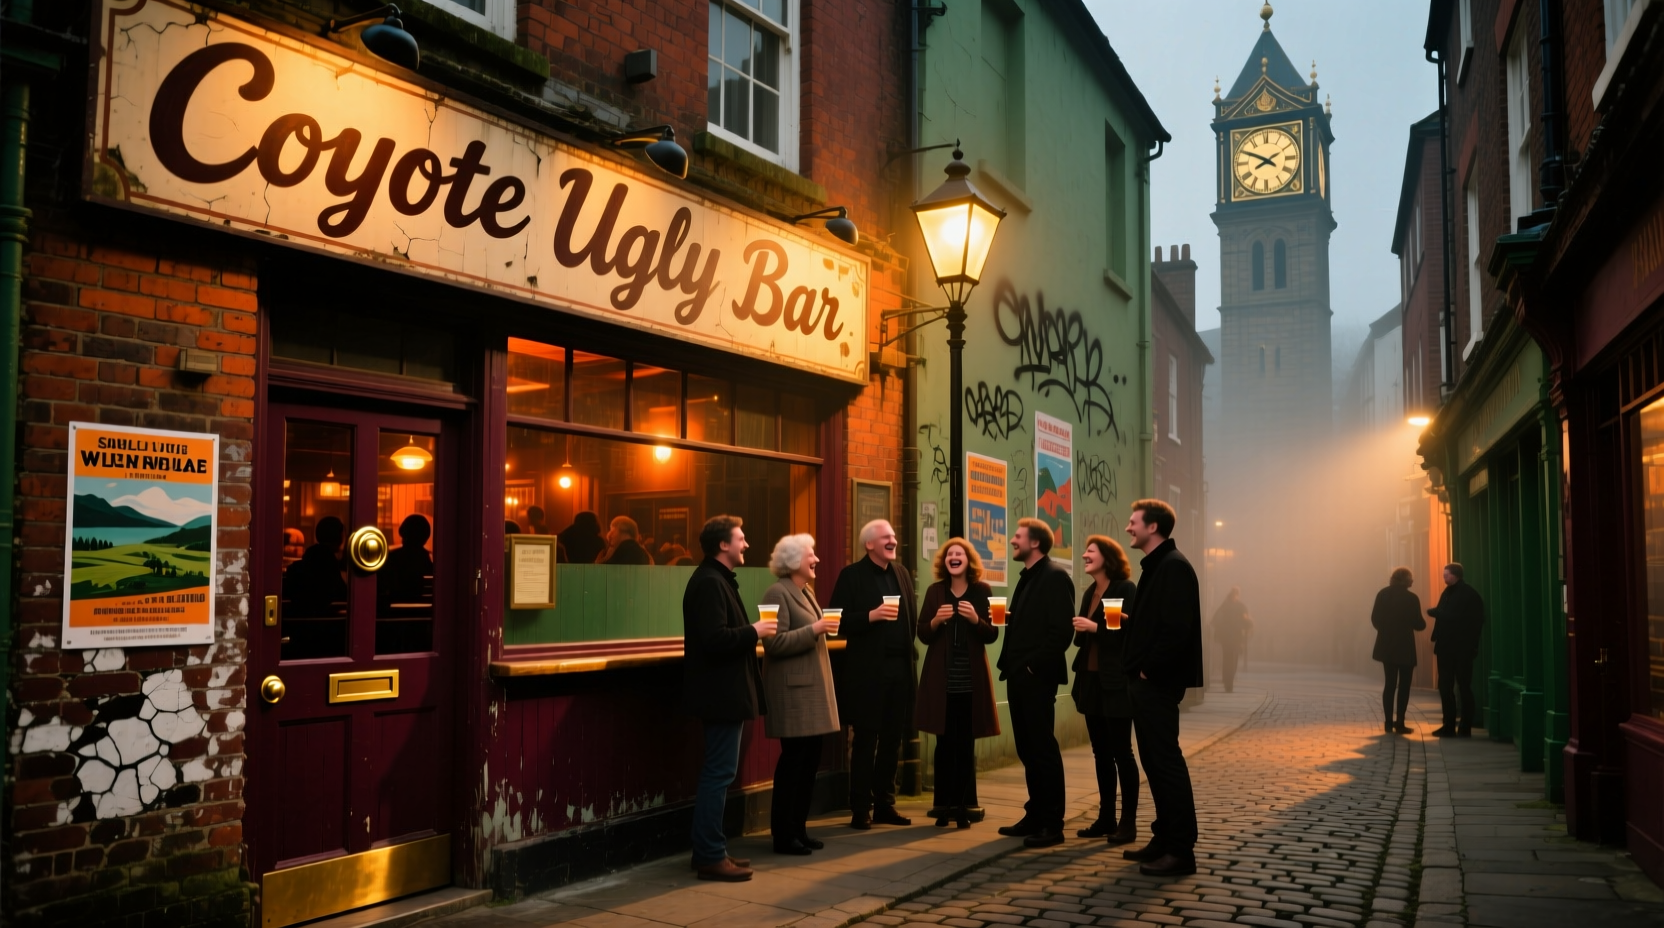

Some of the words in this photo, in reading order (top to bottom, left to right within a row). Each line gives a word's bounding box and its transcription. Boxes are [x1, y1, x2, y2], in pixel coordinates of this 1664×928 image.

[148, 41, 531, 239] Coyote
[553, 168, 720, 325] Ugly
[732, 239, 844, 341] Bar
